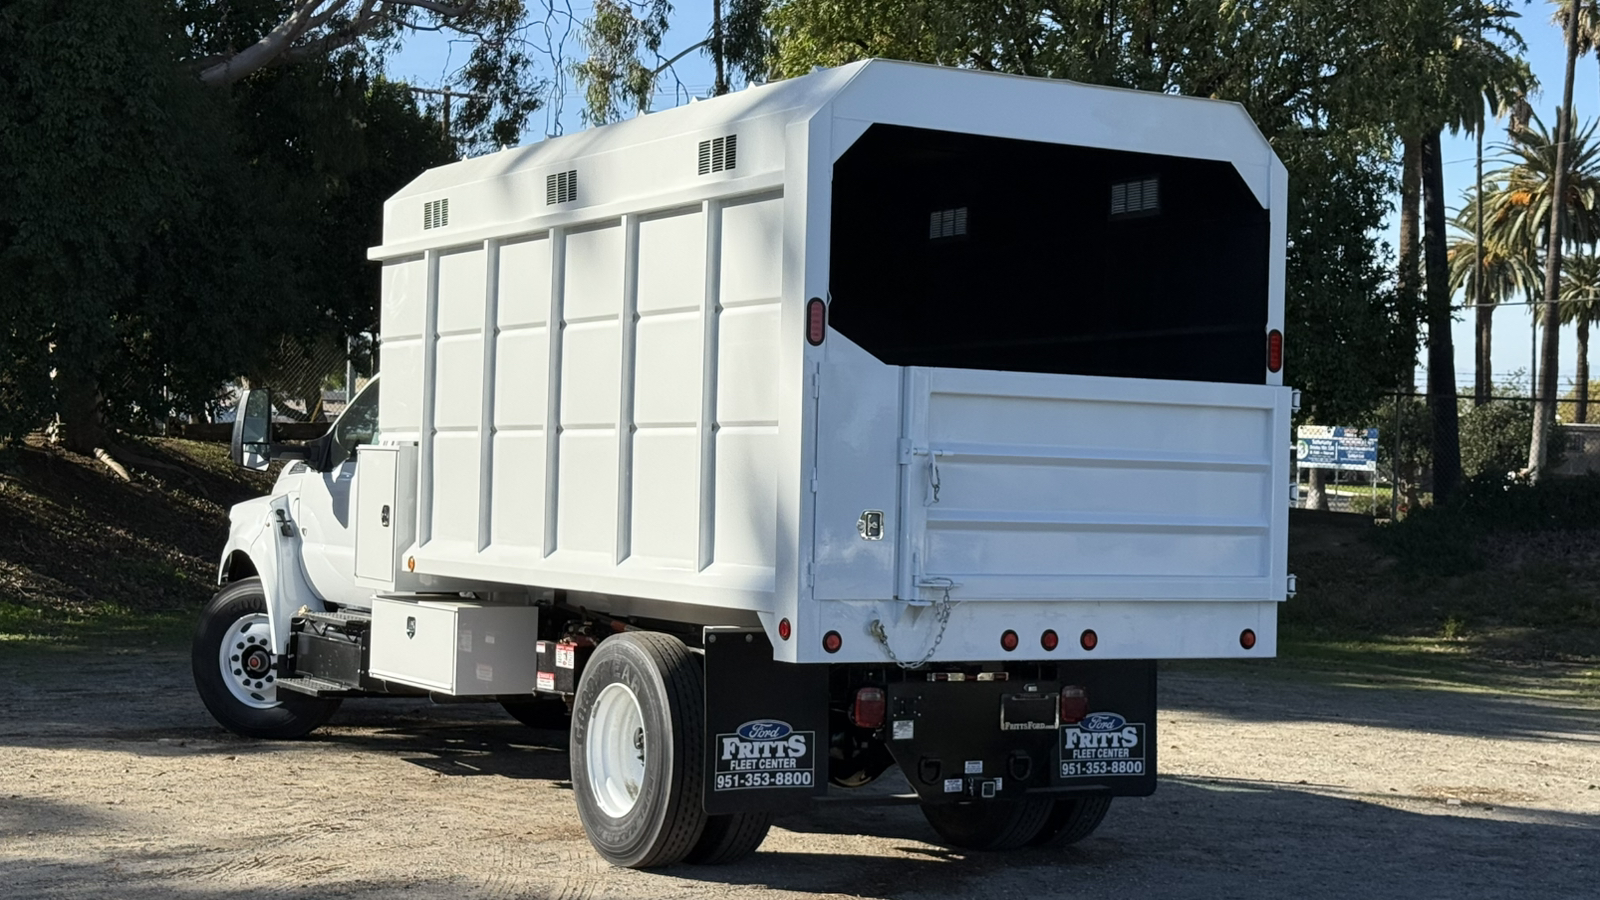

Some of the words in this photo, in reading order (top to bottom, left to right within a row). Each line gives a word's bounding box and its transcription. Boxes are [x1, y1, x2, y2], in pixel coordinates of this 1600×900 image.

[1088, 715, 1115, 729] Ford
[748, 723, 781, 738] Ford
[1065, 727, 1138, 749] FRITTS
[721, 735, 806, 760] FRITTS
[1073, 749, 1096, 759] FLEET
[1097, 748, 1129, 758] CENTER
[730, 759, 757, 770] FLEET
[759, 758, 796, 769] CENTER
[1062, 761, 1142, 775] 951-353-8800
[717, 772, 811, 788] 951-353-8800
